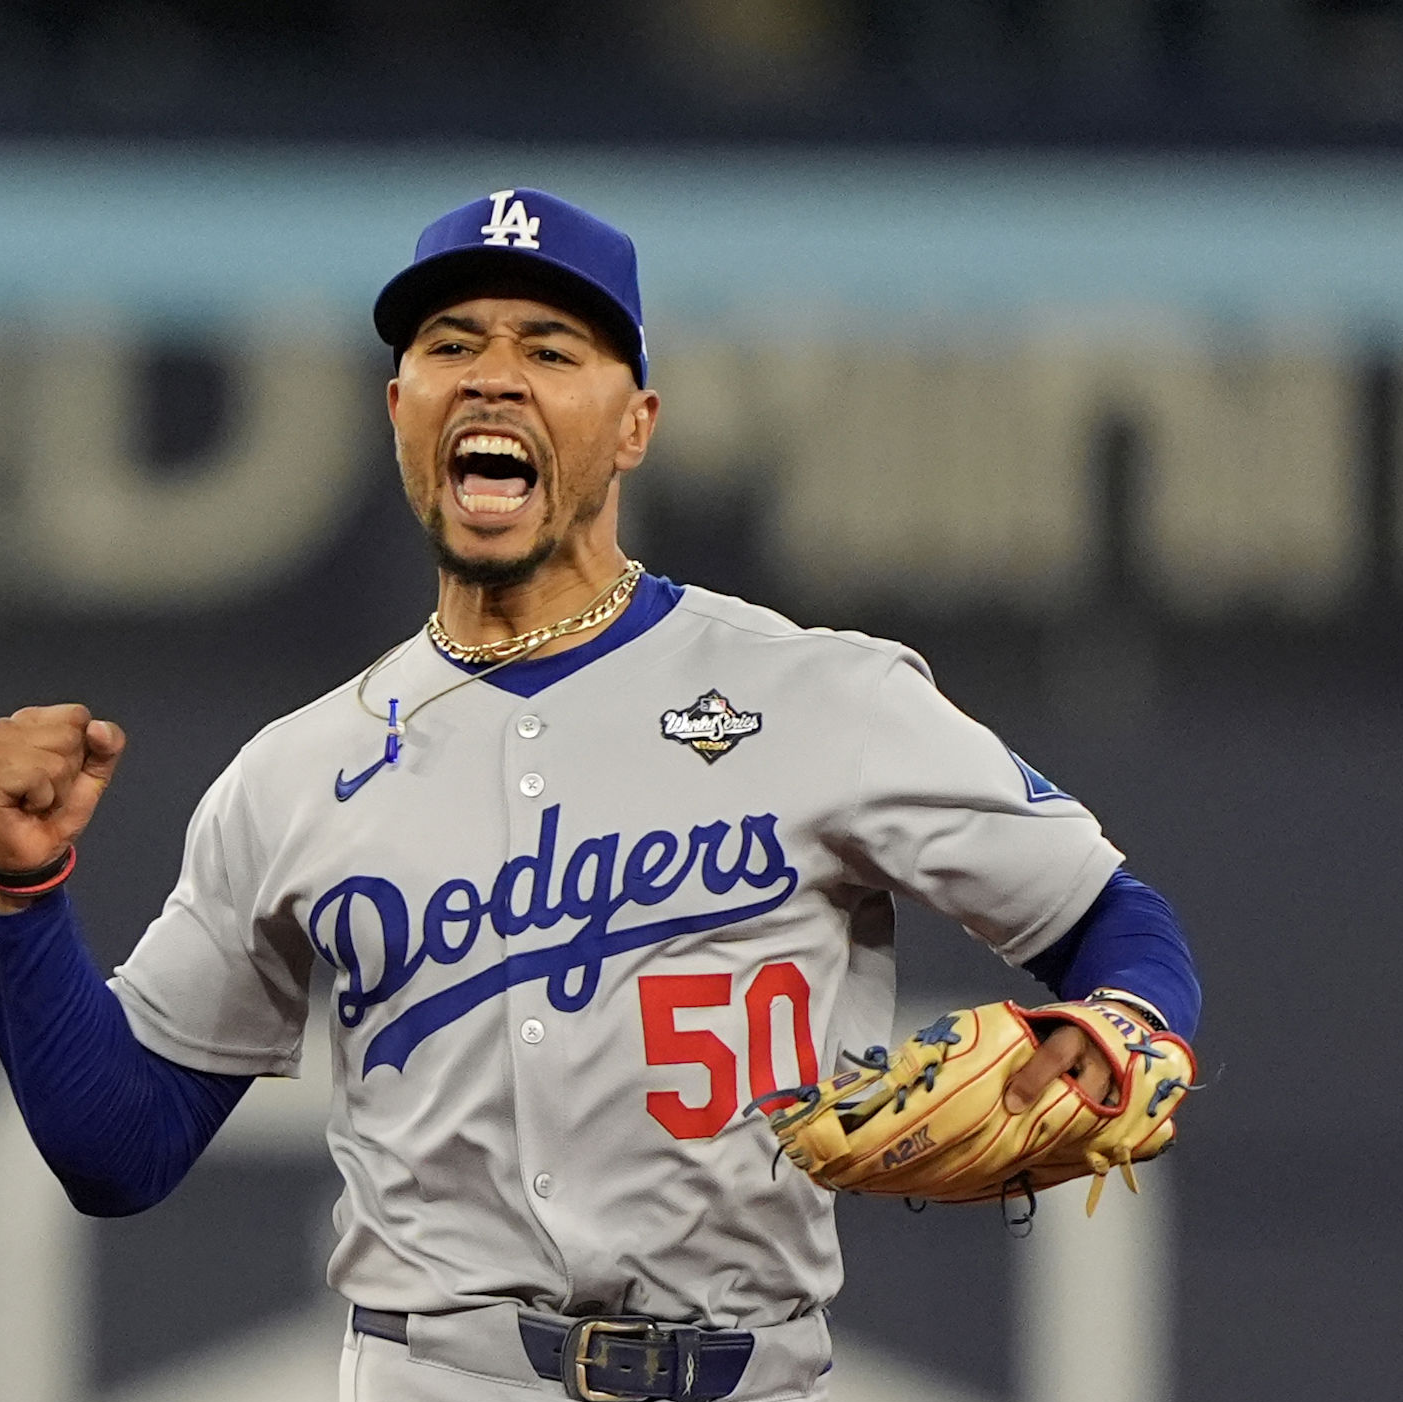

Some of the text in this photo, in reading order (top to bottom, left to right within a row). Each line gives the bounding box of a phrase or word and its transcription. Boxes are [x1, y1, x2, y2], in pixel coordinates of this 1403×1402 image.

[481, 189, 541, 250] LA
[309, 803, 798, 1028] Dodgers
[638, 962, 819, 1140] 50
[882, 1124, 937, 1170] A2K
